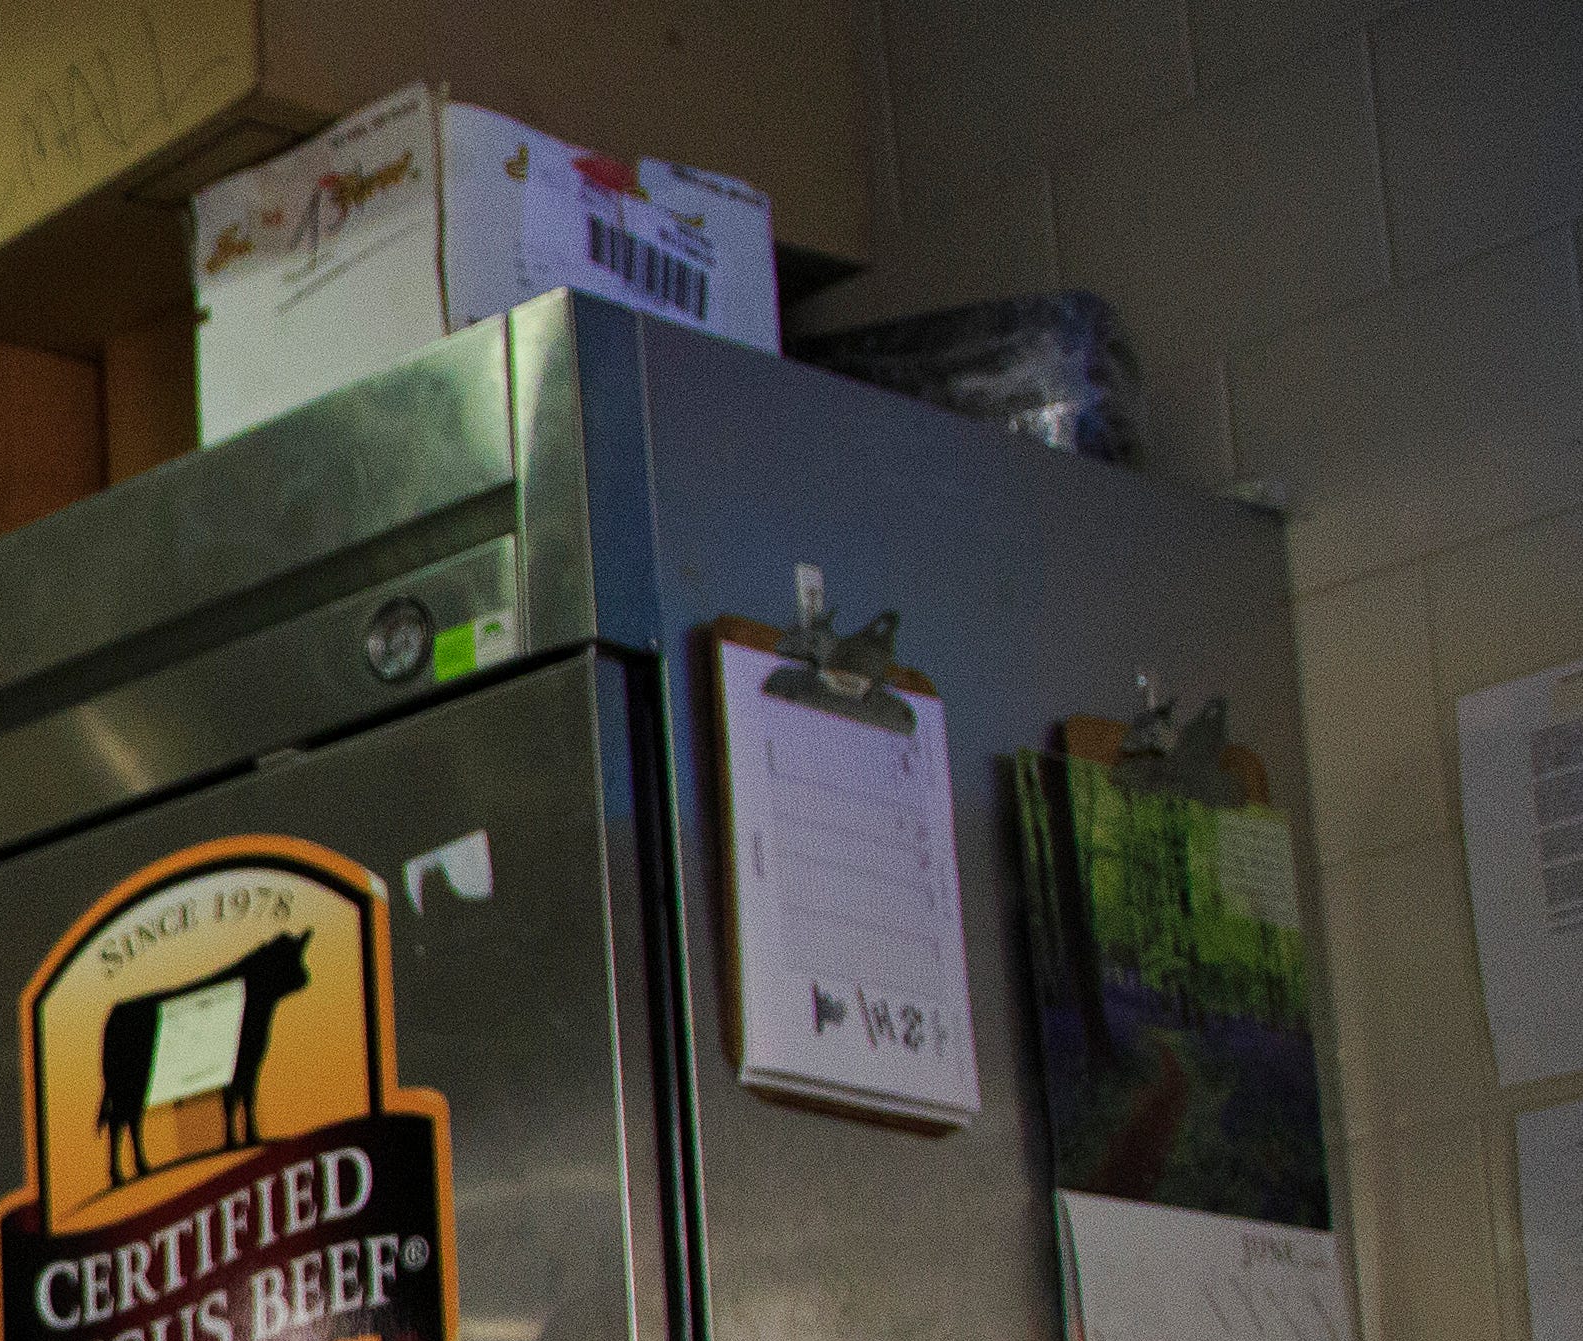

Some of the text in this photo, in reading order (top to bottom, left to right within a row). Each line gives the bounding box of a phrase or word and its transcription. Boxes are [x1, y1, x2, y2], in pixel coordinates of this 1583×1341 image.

[99, 885, 296, 980] SINCE 1978
[38, 1147, 372, 1330] CERTIFIED
